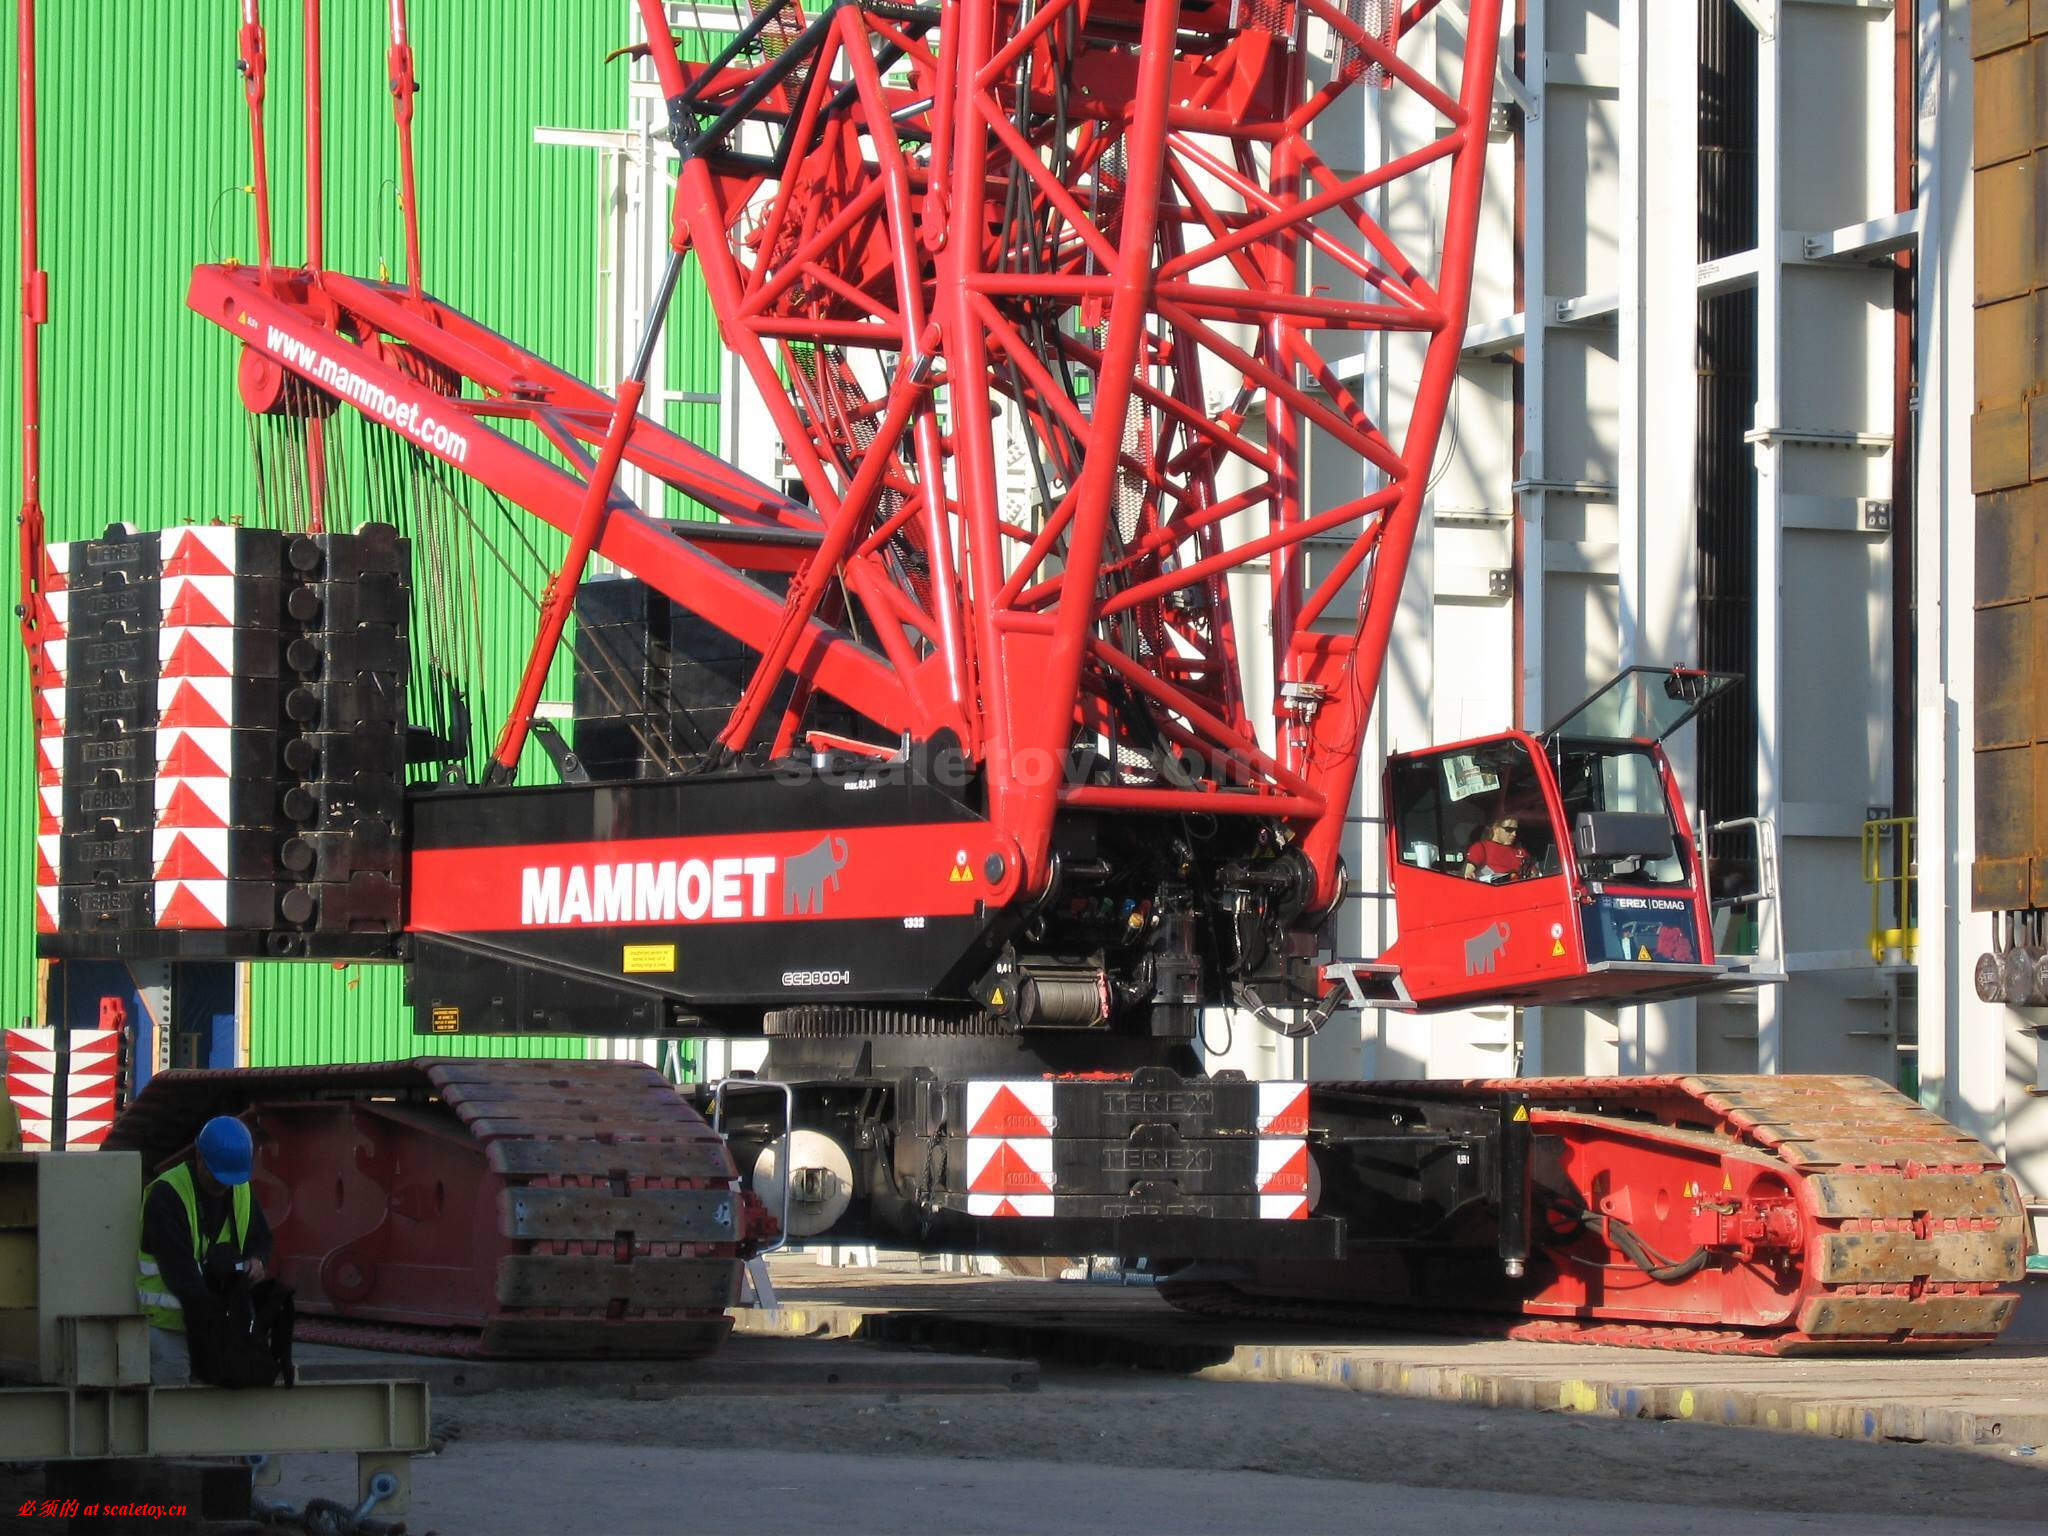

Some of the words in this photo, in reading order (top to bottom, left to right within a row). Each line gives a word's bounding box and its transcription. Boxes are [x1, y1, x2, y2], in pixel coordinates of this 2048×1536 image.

[266, 324, 468, 462] www.mammoet.com
[520, 856, 776, 926] MAMMOET
[1651, 900, 1685, 911] DEMAG
[1103, 1091, 1212, 1113] TEREX
[1103, 1148, 1209, 1170] TEREX
